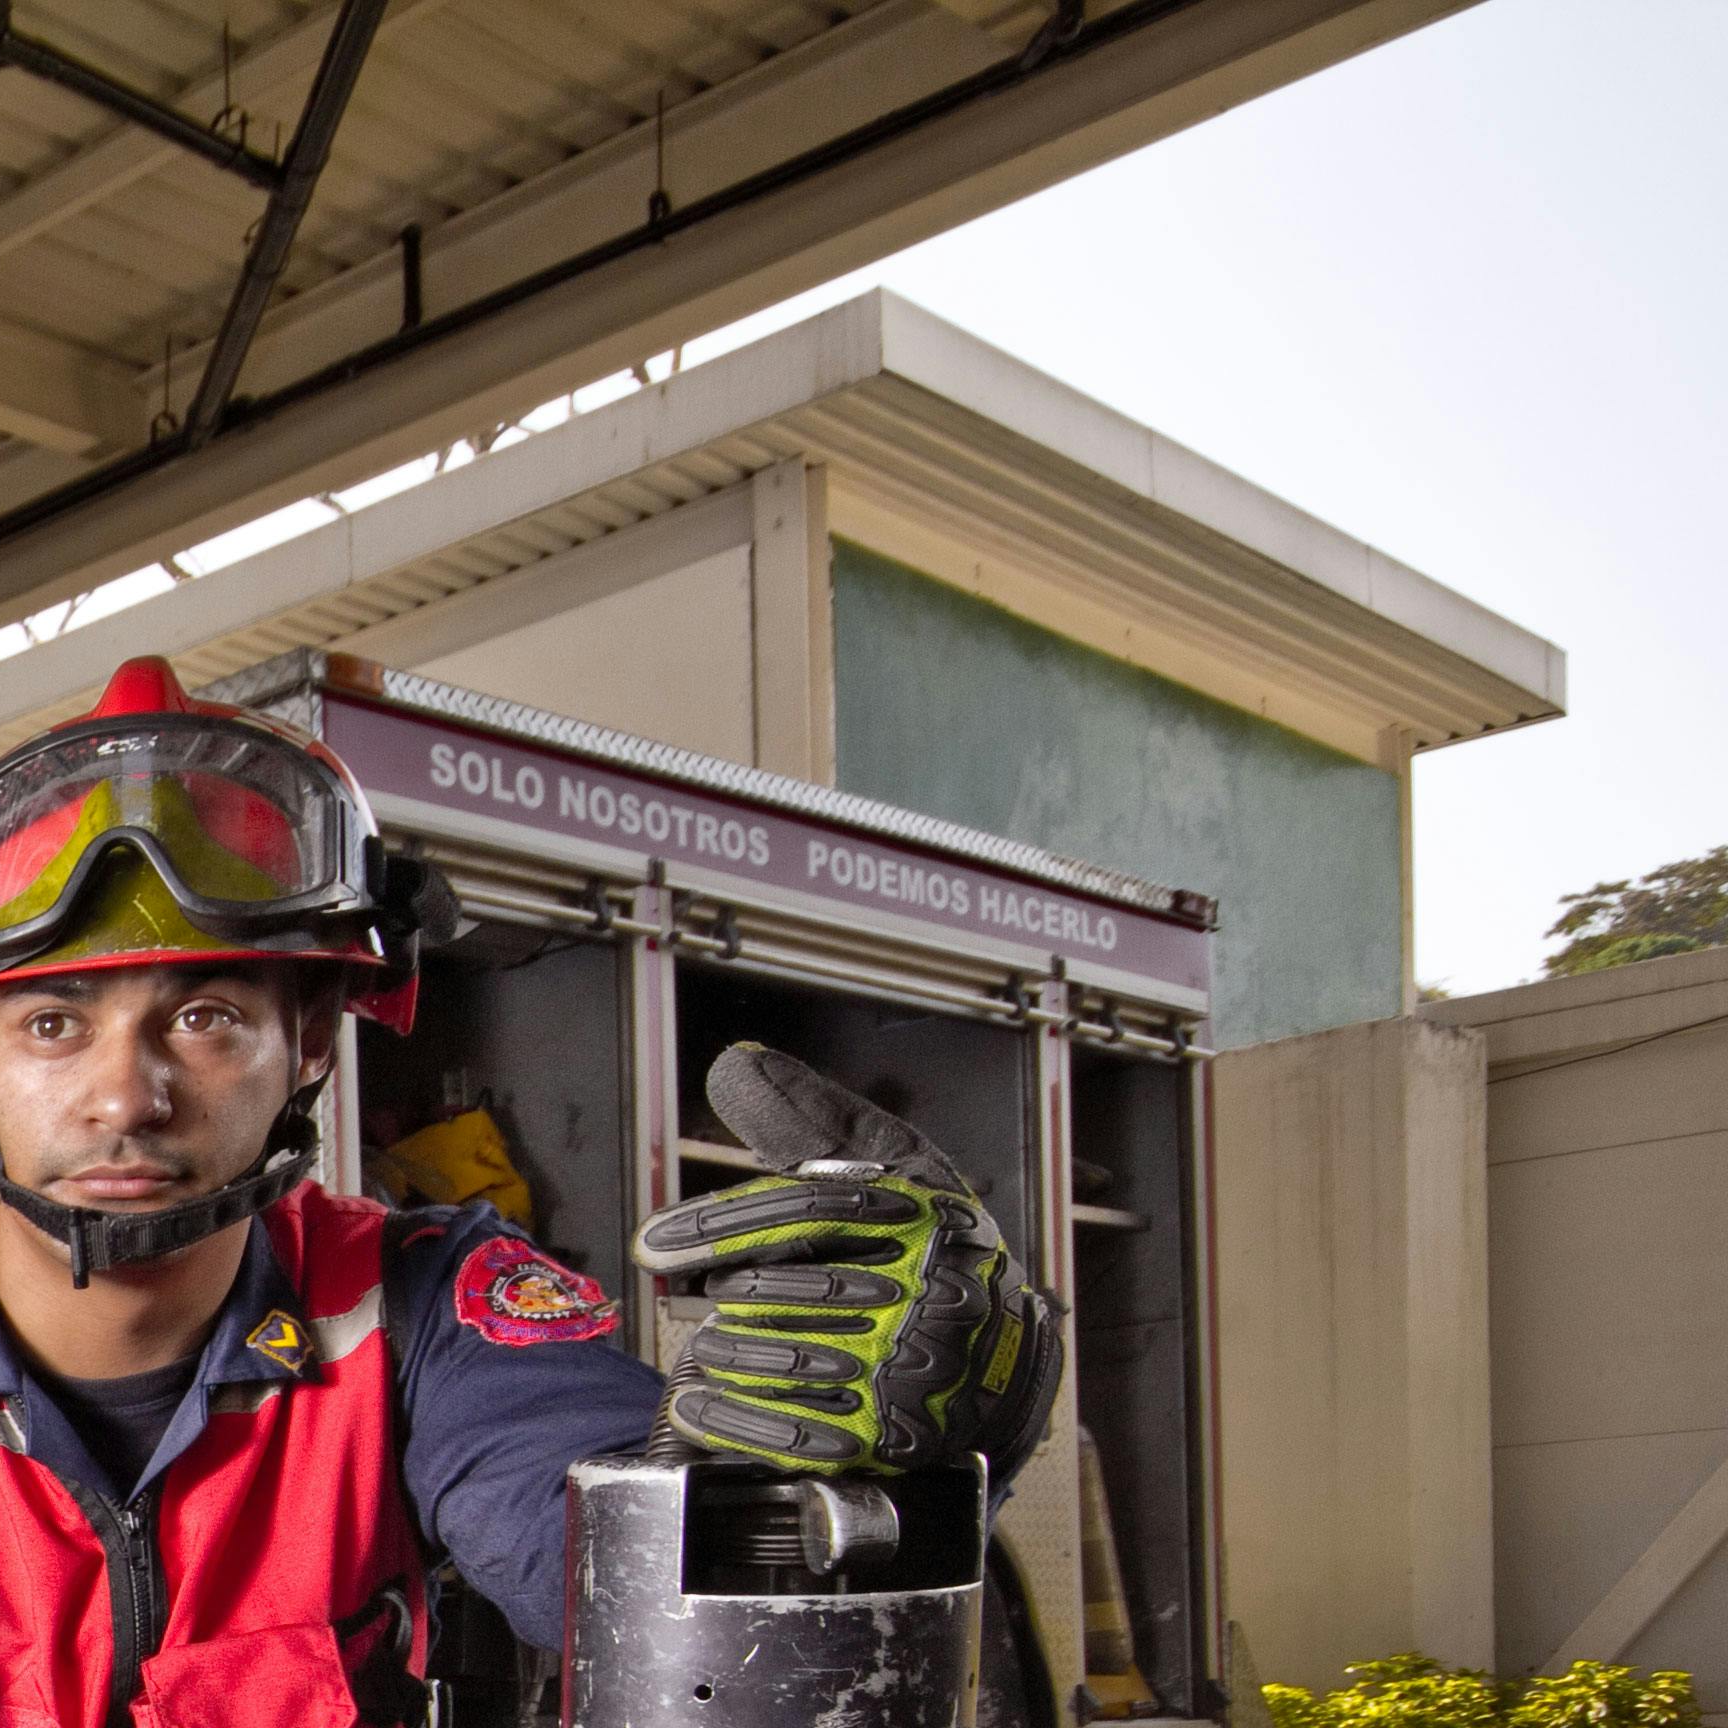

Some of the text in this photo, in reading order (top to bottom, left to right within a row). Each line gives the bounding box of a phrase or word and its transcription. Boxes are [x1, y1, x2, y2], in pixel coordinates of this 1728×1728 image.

[430, 743, 1118, 950] SOLO NOSOTROS PODEMOS HACERLO
